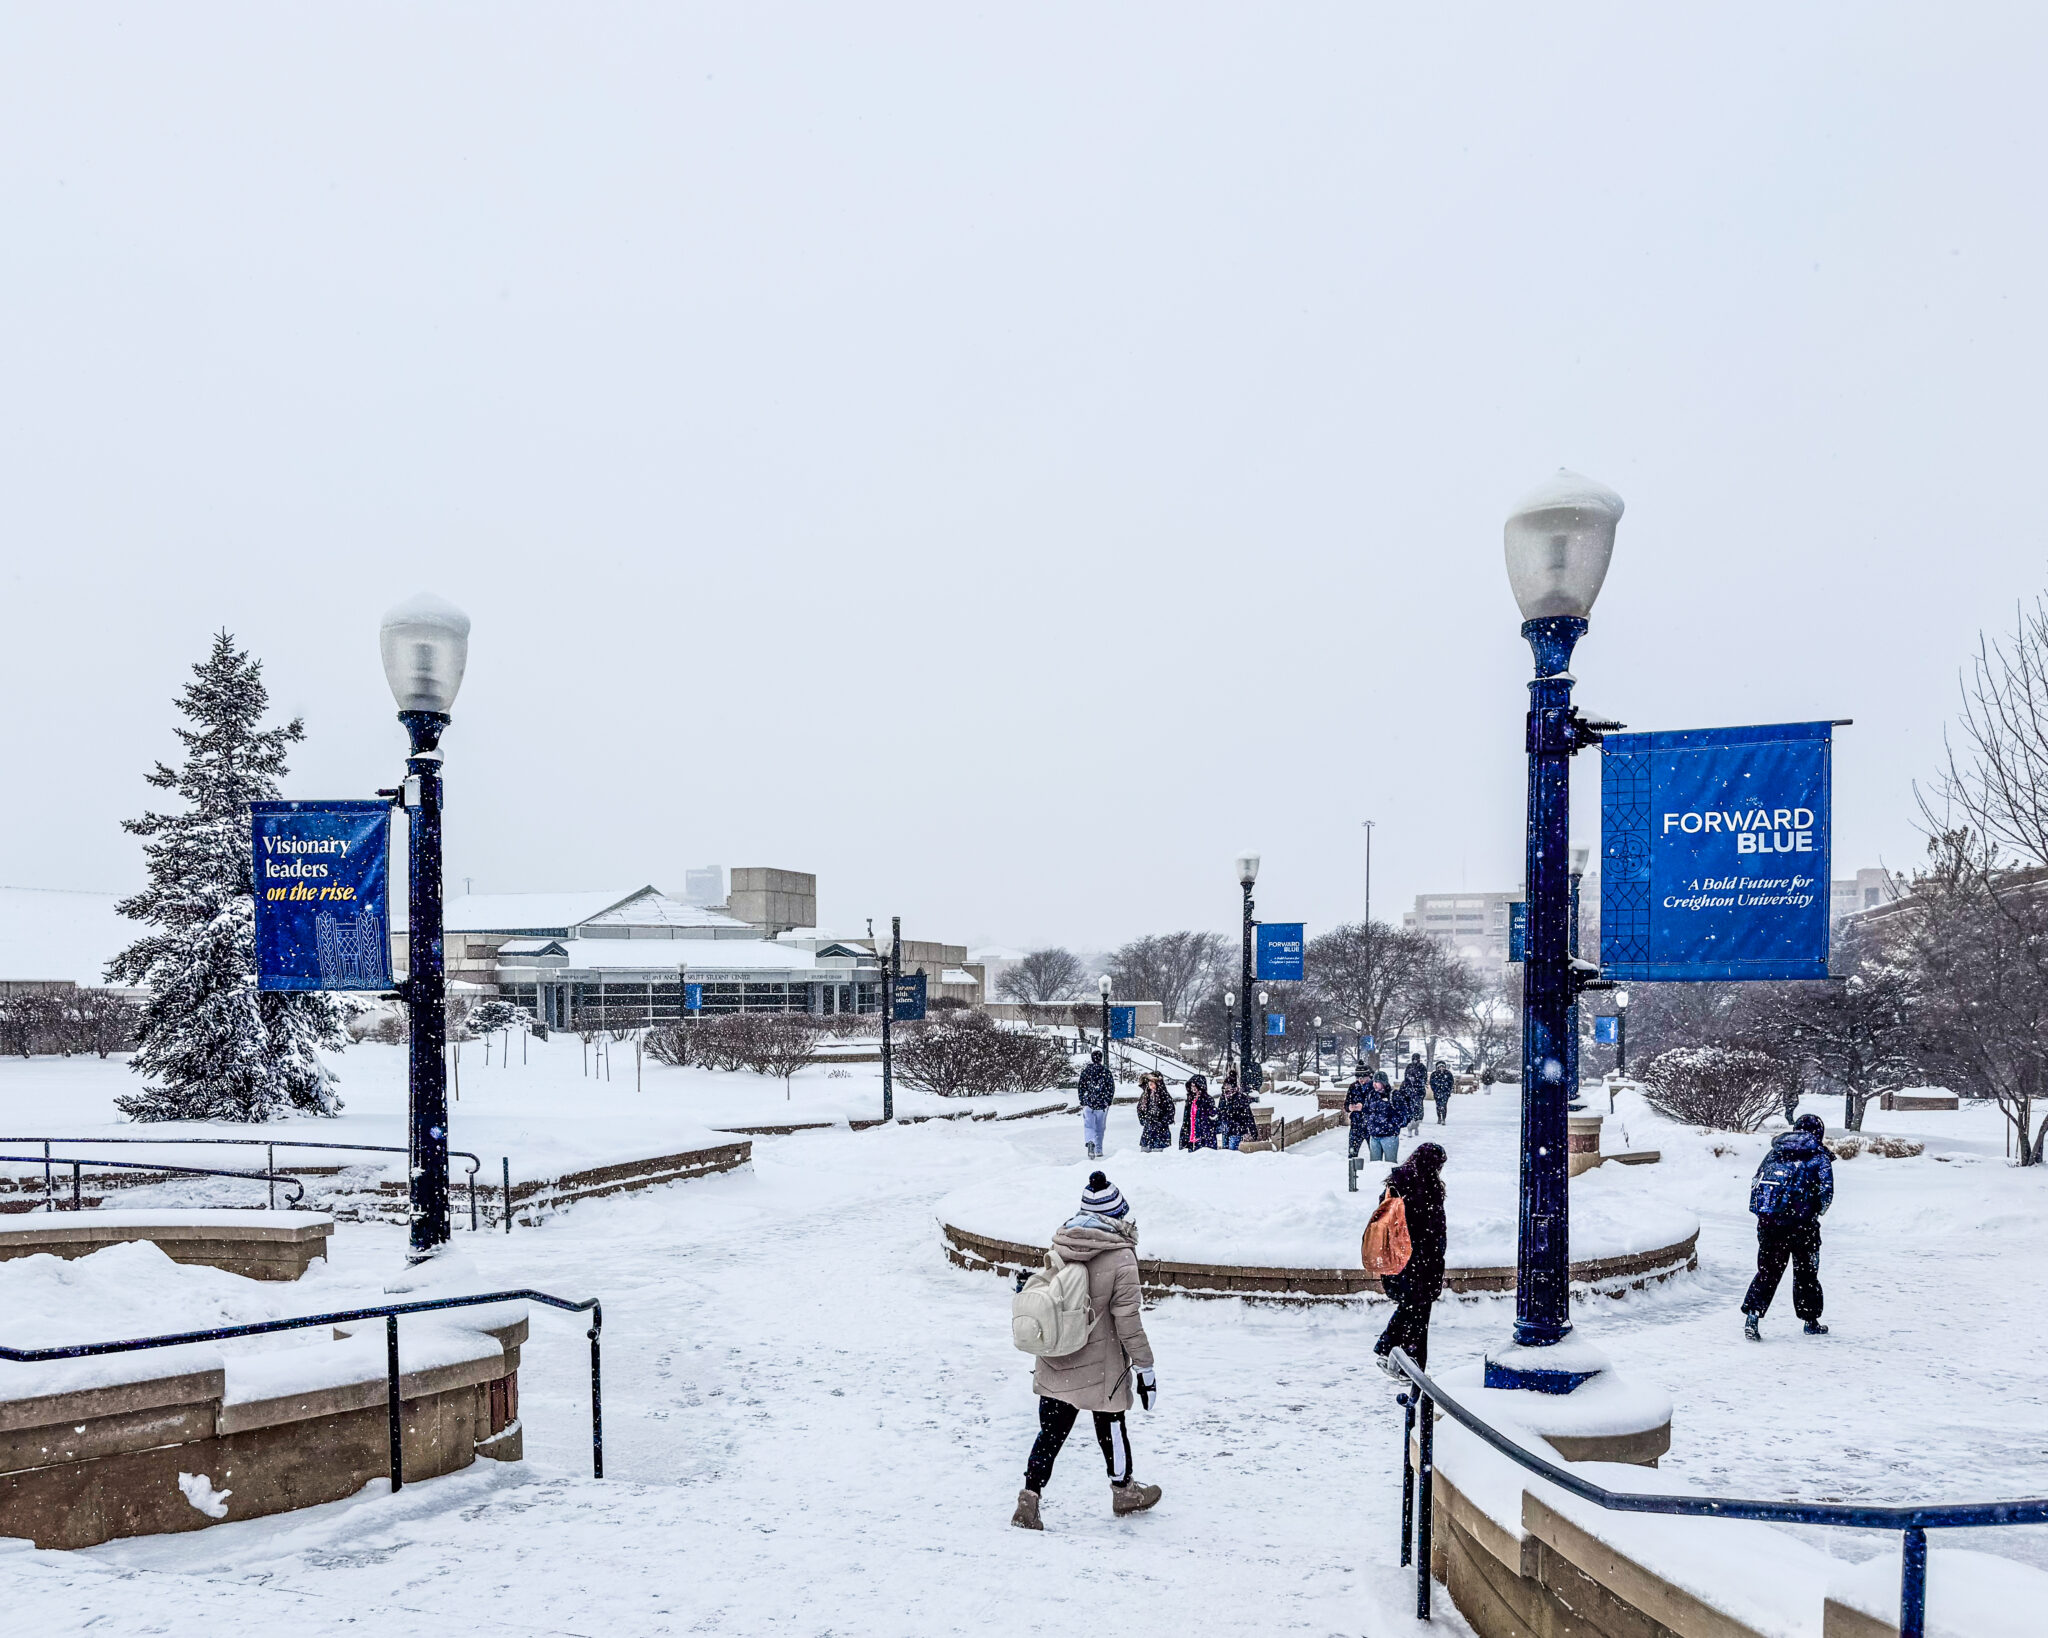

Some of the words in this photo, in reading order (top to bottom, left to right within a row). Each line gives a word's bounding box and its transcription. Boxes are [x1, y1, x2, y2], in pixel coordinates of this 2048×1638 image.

[1663, 808, 1814, 834] FORWARD
[262, 835, 351, 859] Visionary
[1737, 831, 1813, 854] BLUE
[265, 858, 328, 878] leaders
[266, 888, 287, 901] on
[289, 881, 317, 901] the
[319, 882, 357, 901] rise.
[1688, 878, 1699, 891] A
[1702, 876, 1738, 890] Bold
[1739, 877, 1788, 889] Future
[1790, 874, 1814, 892] for
[1663, 895, 1734, 911] Creighton
[1737, 893, 1814, 908] University
